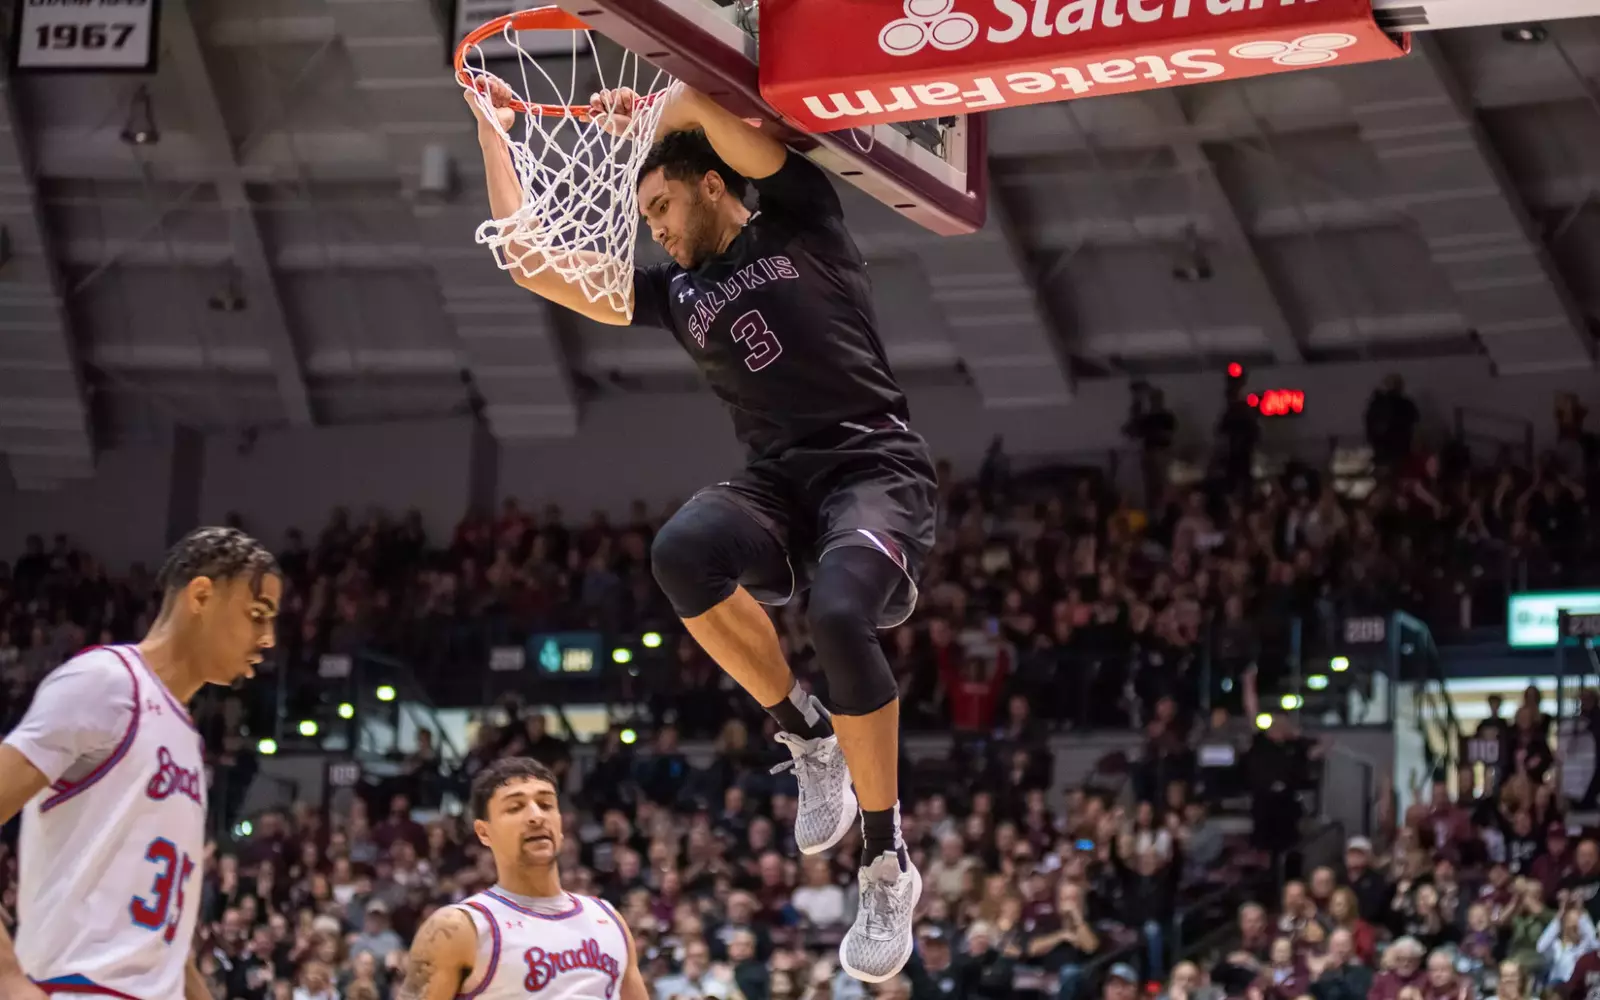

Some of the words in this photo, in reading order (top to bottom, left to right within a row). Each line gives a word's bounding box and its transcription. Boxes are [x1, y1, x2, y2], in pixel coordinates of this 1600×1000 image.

[36, 23, 137, 50] 1967
[688, 255, 799, 348] SALUKIS
[731, 309, 783, 372] 3
[524, 937, 621, 999] Bradley
